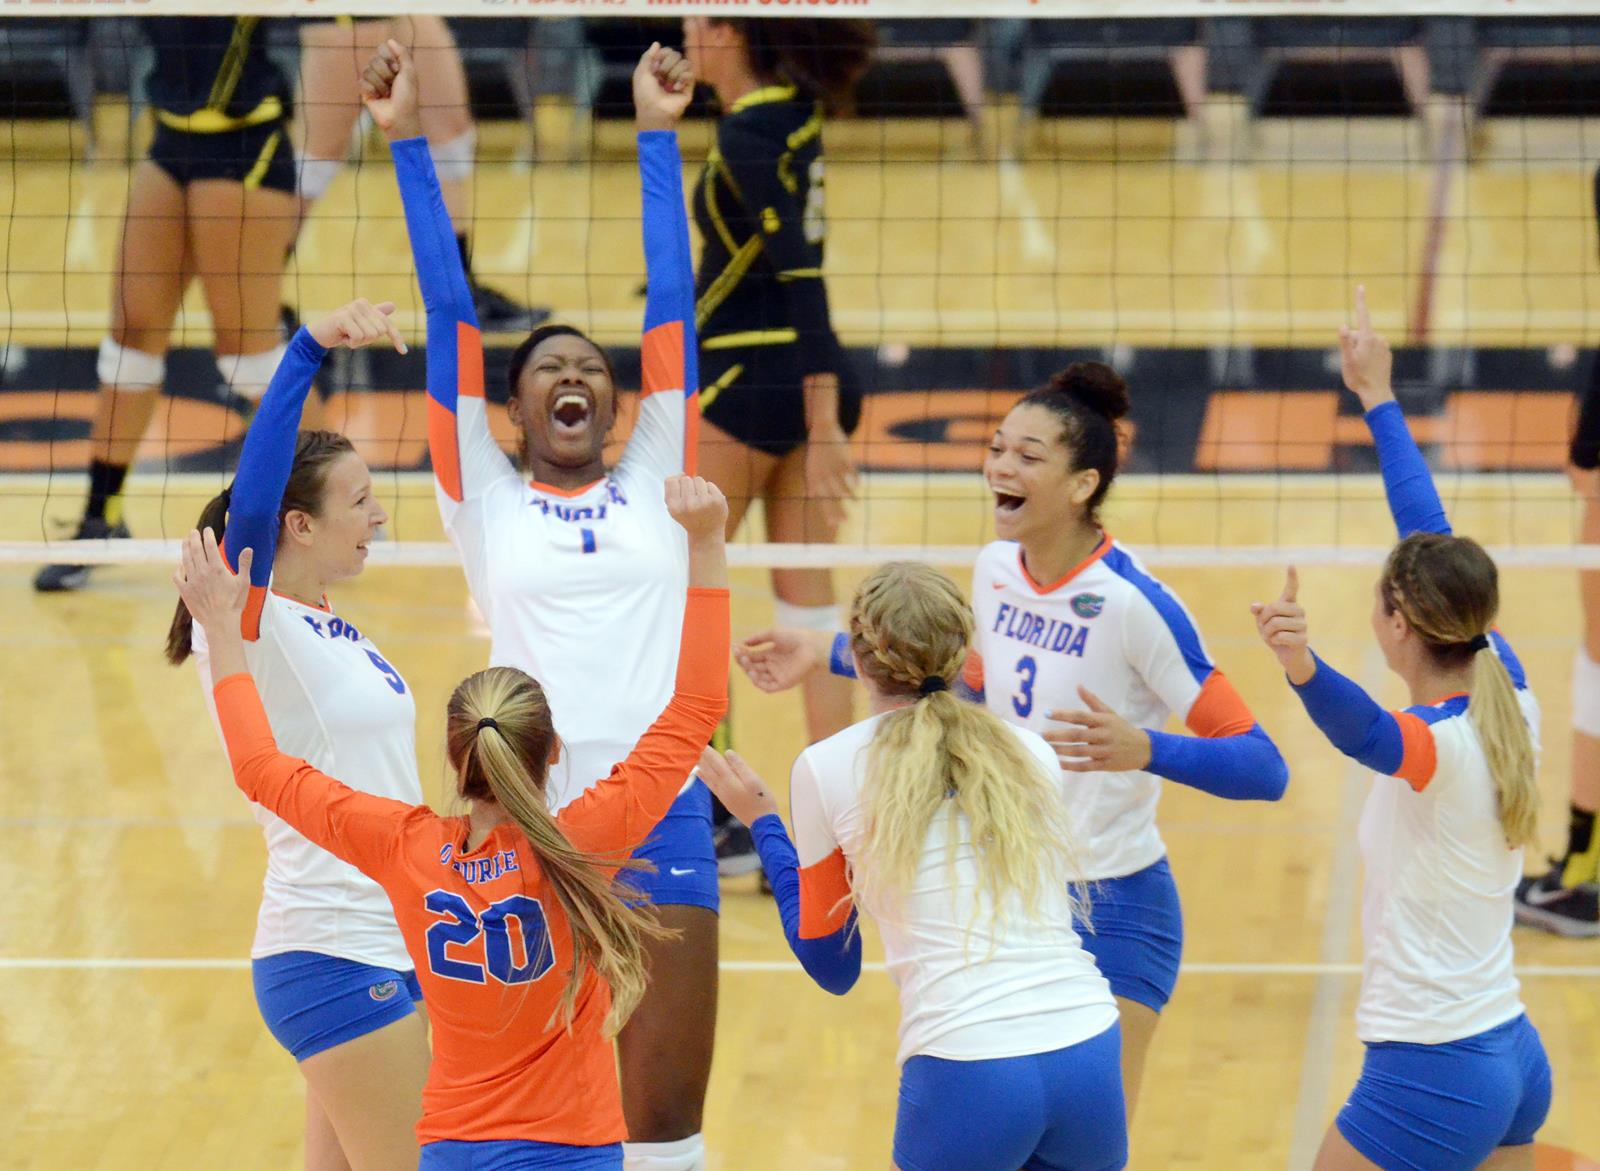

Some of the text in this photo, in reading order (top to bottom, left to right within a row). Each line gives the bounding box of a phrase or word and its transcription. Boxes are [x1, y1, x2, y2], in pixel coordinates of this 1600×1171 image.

[991, 601, 1090, 658] FLORIDA
[1010, 653, 1037, 719] 3
[424, 887, 556, 985] 20
